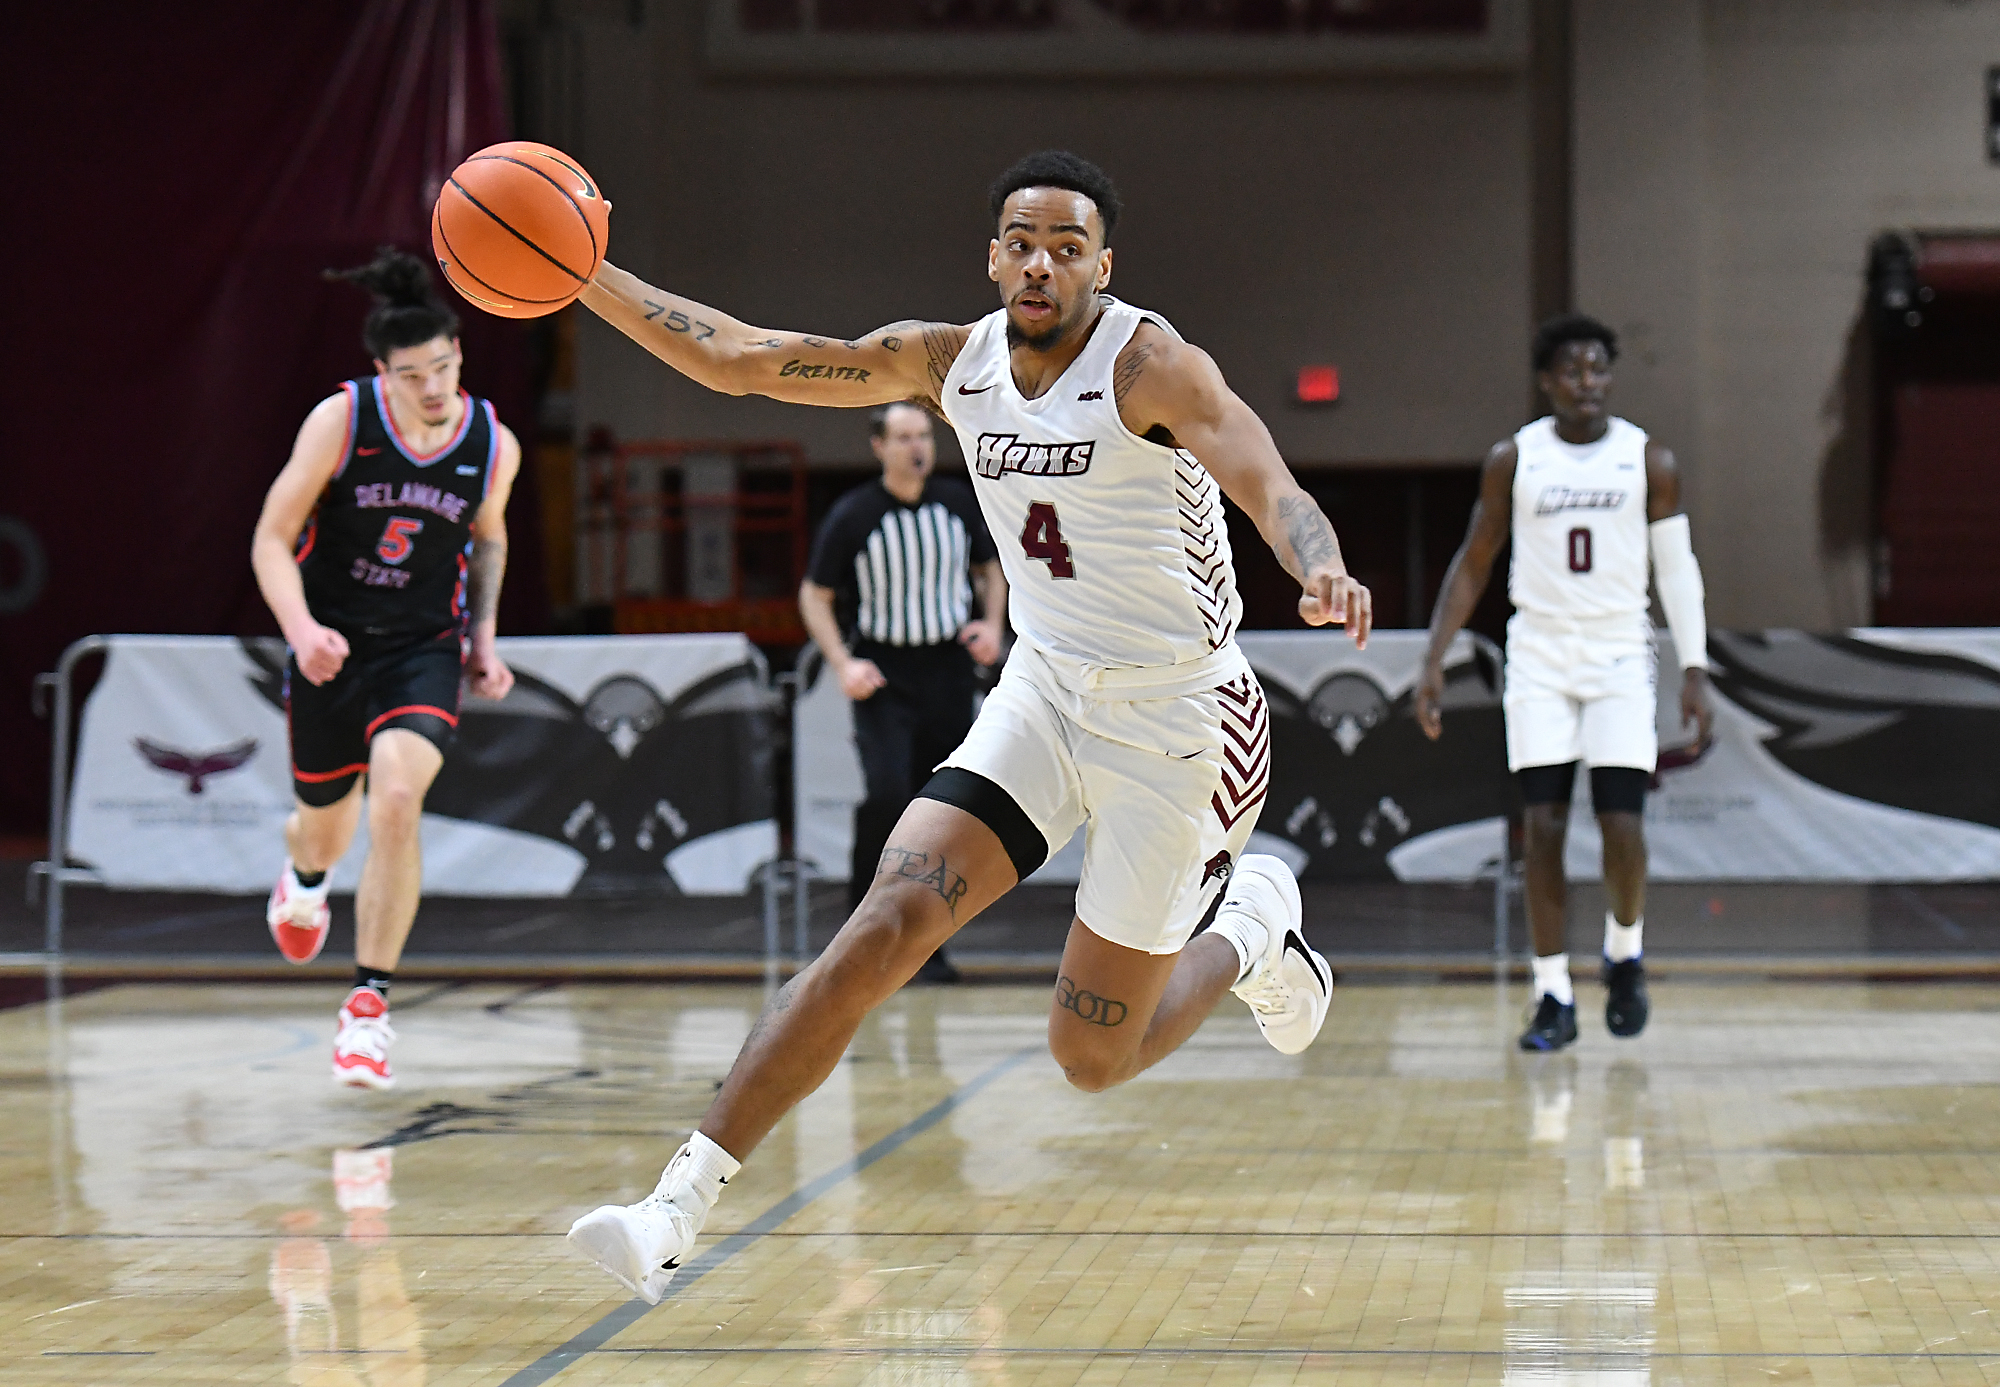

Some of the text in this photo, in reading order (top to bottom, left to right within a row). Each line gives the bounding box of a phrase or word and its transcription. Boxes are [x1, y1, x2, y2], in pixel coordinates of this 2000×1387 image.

[643, 299, 716, 341] 757
[779, 359, 871, 383] GREATER
[976, 432, 1096, 480] HAWKS
[376, 516, 424, 565] 5
[1018, 500, 1077, 581] 4
[1569, 528, 1592, 573] 0
[879, 846, 967, 922] FEAR
[1055, 976, 1127, 1027] GOD
